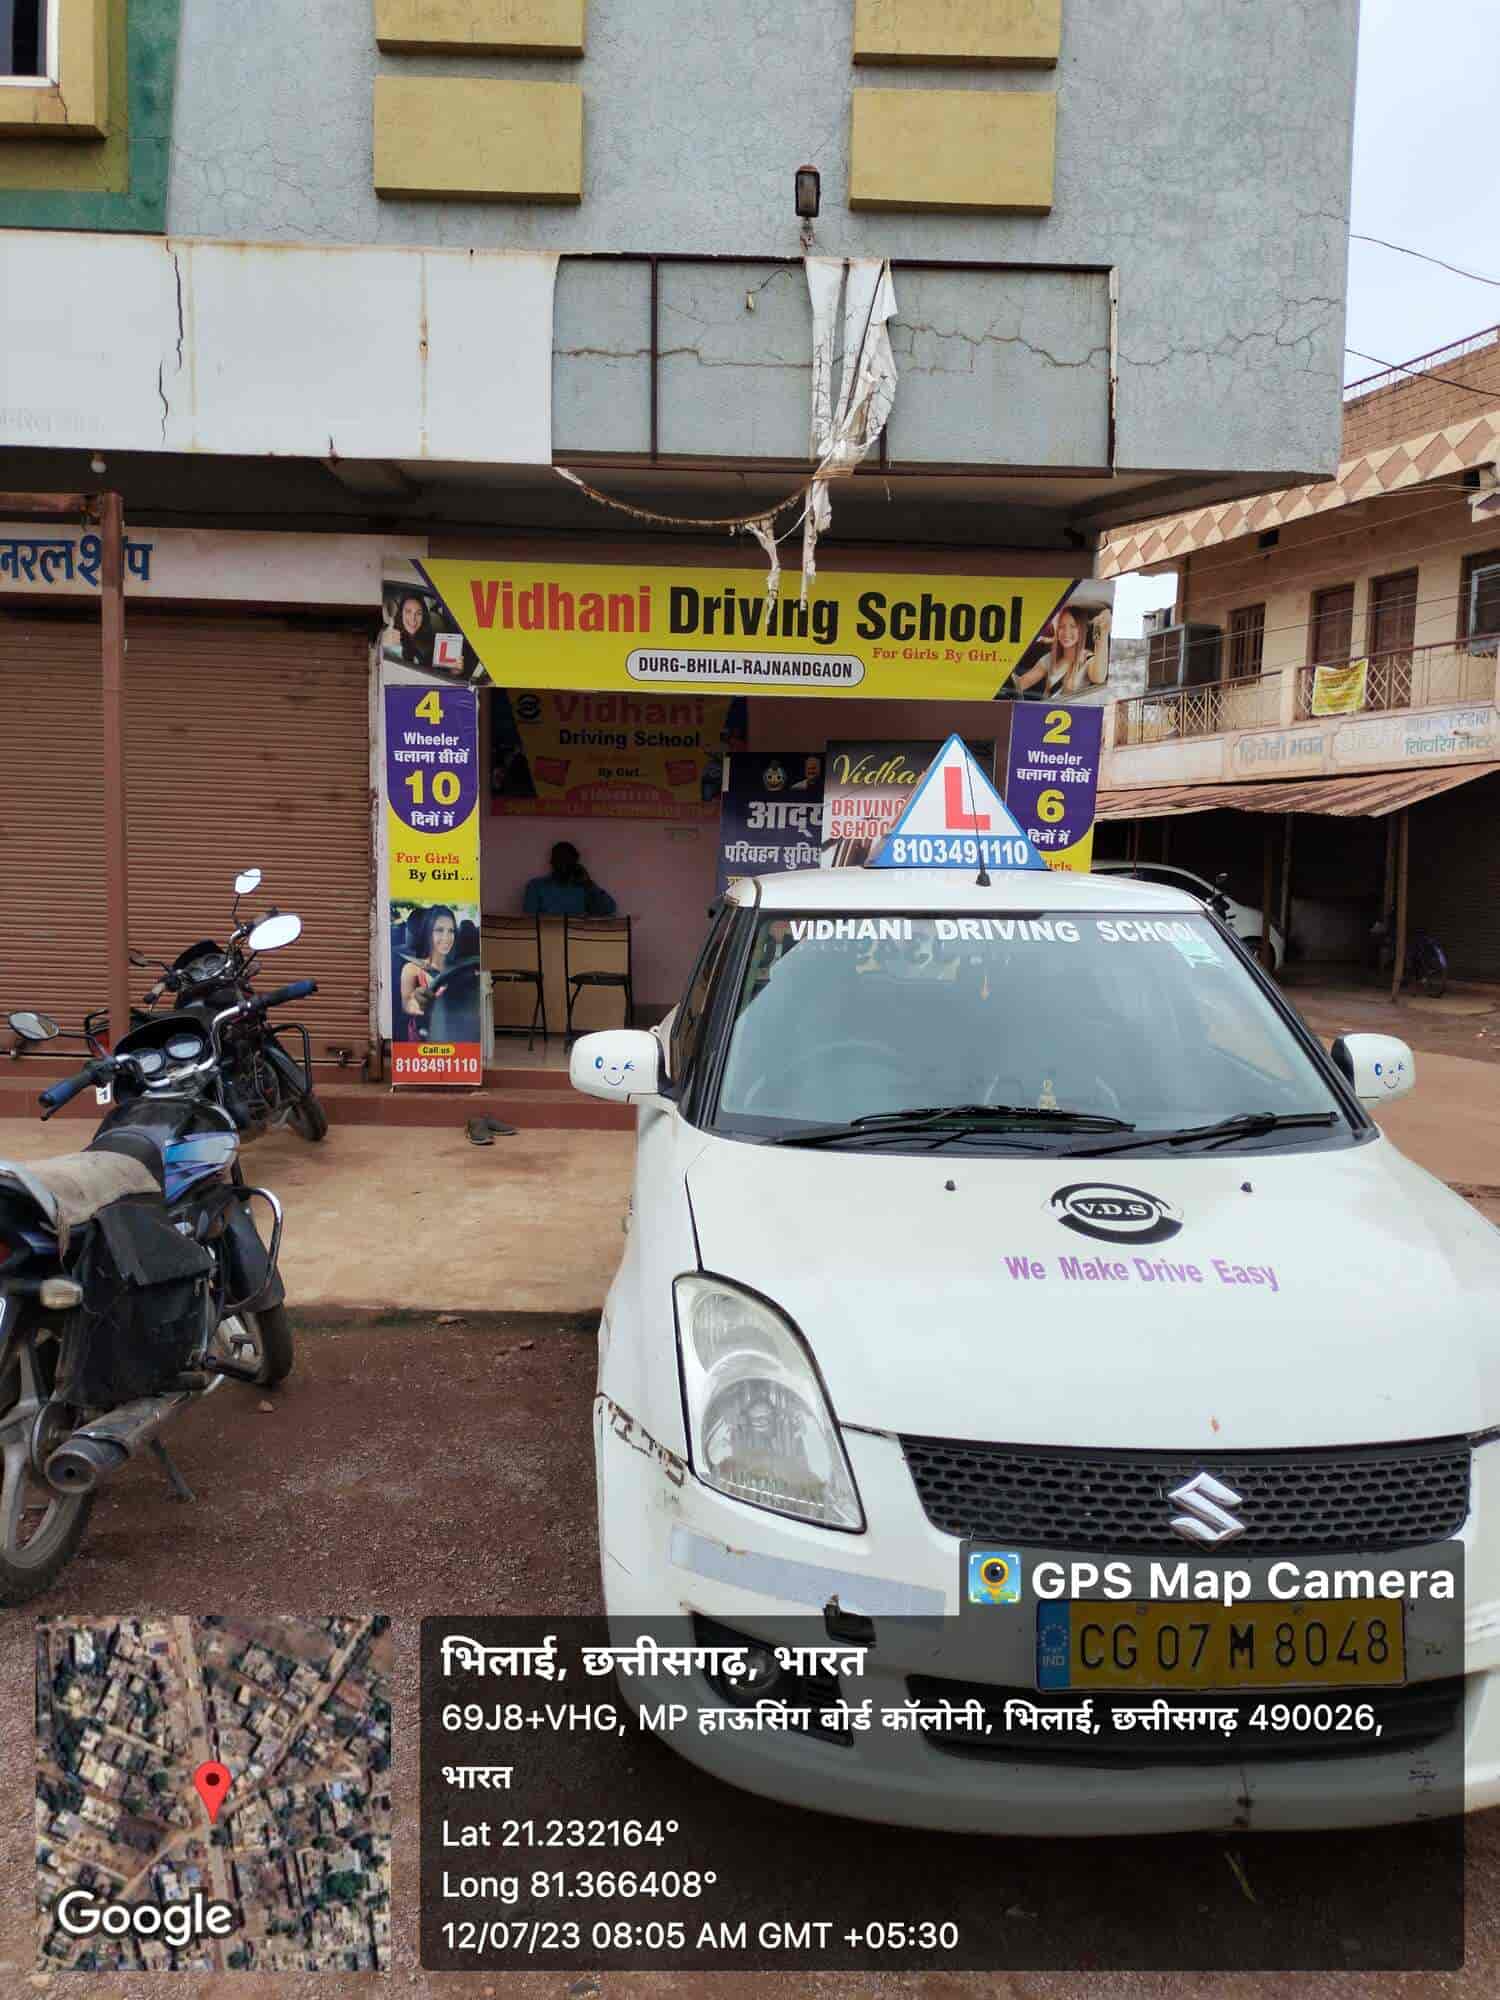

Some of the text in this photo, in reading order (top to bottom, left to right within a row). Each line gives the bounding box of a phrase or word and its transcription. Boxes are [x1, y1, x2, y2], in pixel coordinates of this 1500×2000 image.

[470, 580, 1023, 645] Vidhani Driving School
[873, 647, 898, 660] For
[903, 647, 938, 661] Girls
[945, 648, 962, 664] By
[639, 656, 853, 679] DURG-BHILAI-RAJNANDGAON
[415, 690, 444, 725] 4
[553, 694, 704, 726] Vidhani
[1042, 709, 1072, 744] 2
[403, 732, 459, 746] Wheeler
[559, 729, 700, 749] Driving School
[394, 748, 470, 764] चलाना सीखें
[1027, 750, 1083, 766] Wheeler
[833, 754, 917, 788] Vidha
[1016, 767, 1091, 784] चलाना सीखें
[405, 769, 461, 805] 10
[943, 767, 991, 831] L
[1036, 789, 1065, 823] 6
[411, 810, 455, 827] दिनों में
[831, 821, 889, 839] SCHOO
[1058, 829, 1071, 846] में
[396, 852, 460, 864] For Girls
[725, 840, 780, 863] परिवहन
[891, 839, 1029, 866] 8103491110
[409, 869, 427, 882] By
[1046, 860, 1073, 871] irls
[789, 919, 913, 941] VIDHANI
[935, 919, 1080, 942] DRIVING
[422, 1046, 450, 1054] Call us
[395, 1058, 478, 1073] 8103491110
[1075, 1201, 1149, 1217] V.D.S
[1004, 1256, 1280, 1292] We Make Drive Easy
[1080, 1619, 1390, 1670] CG 07 M 8048
